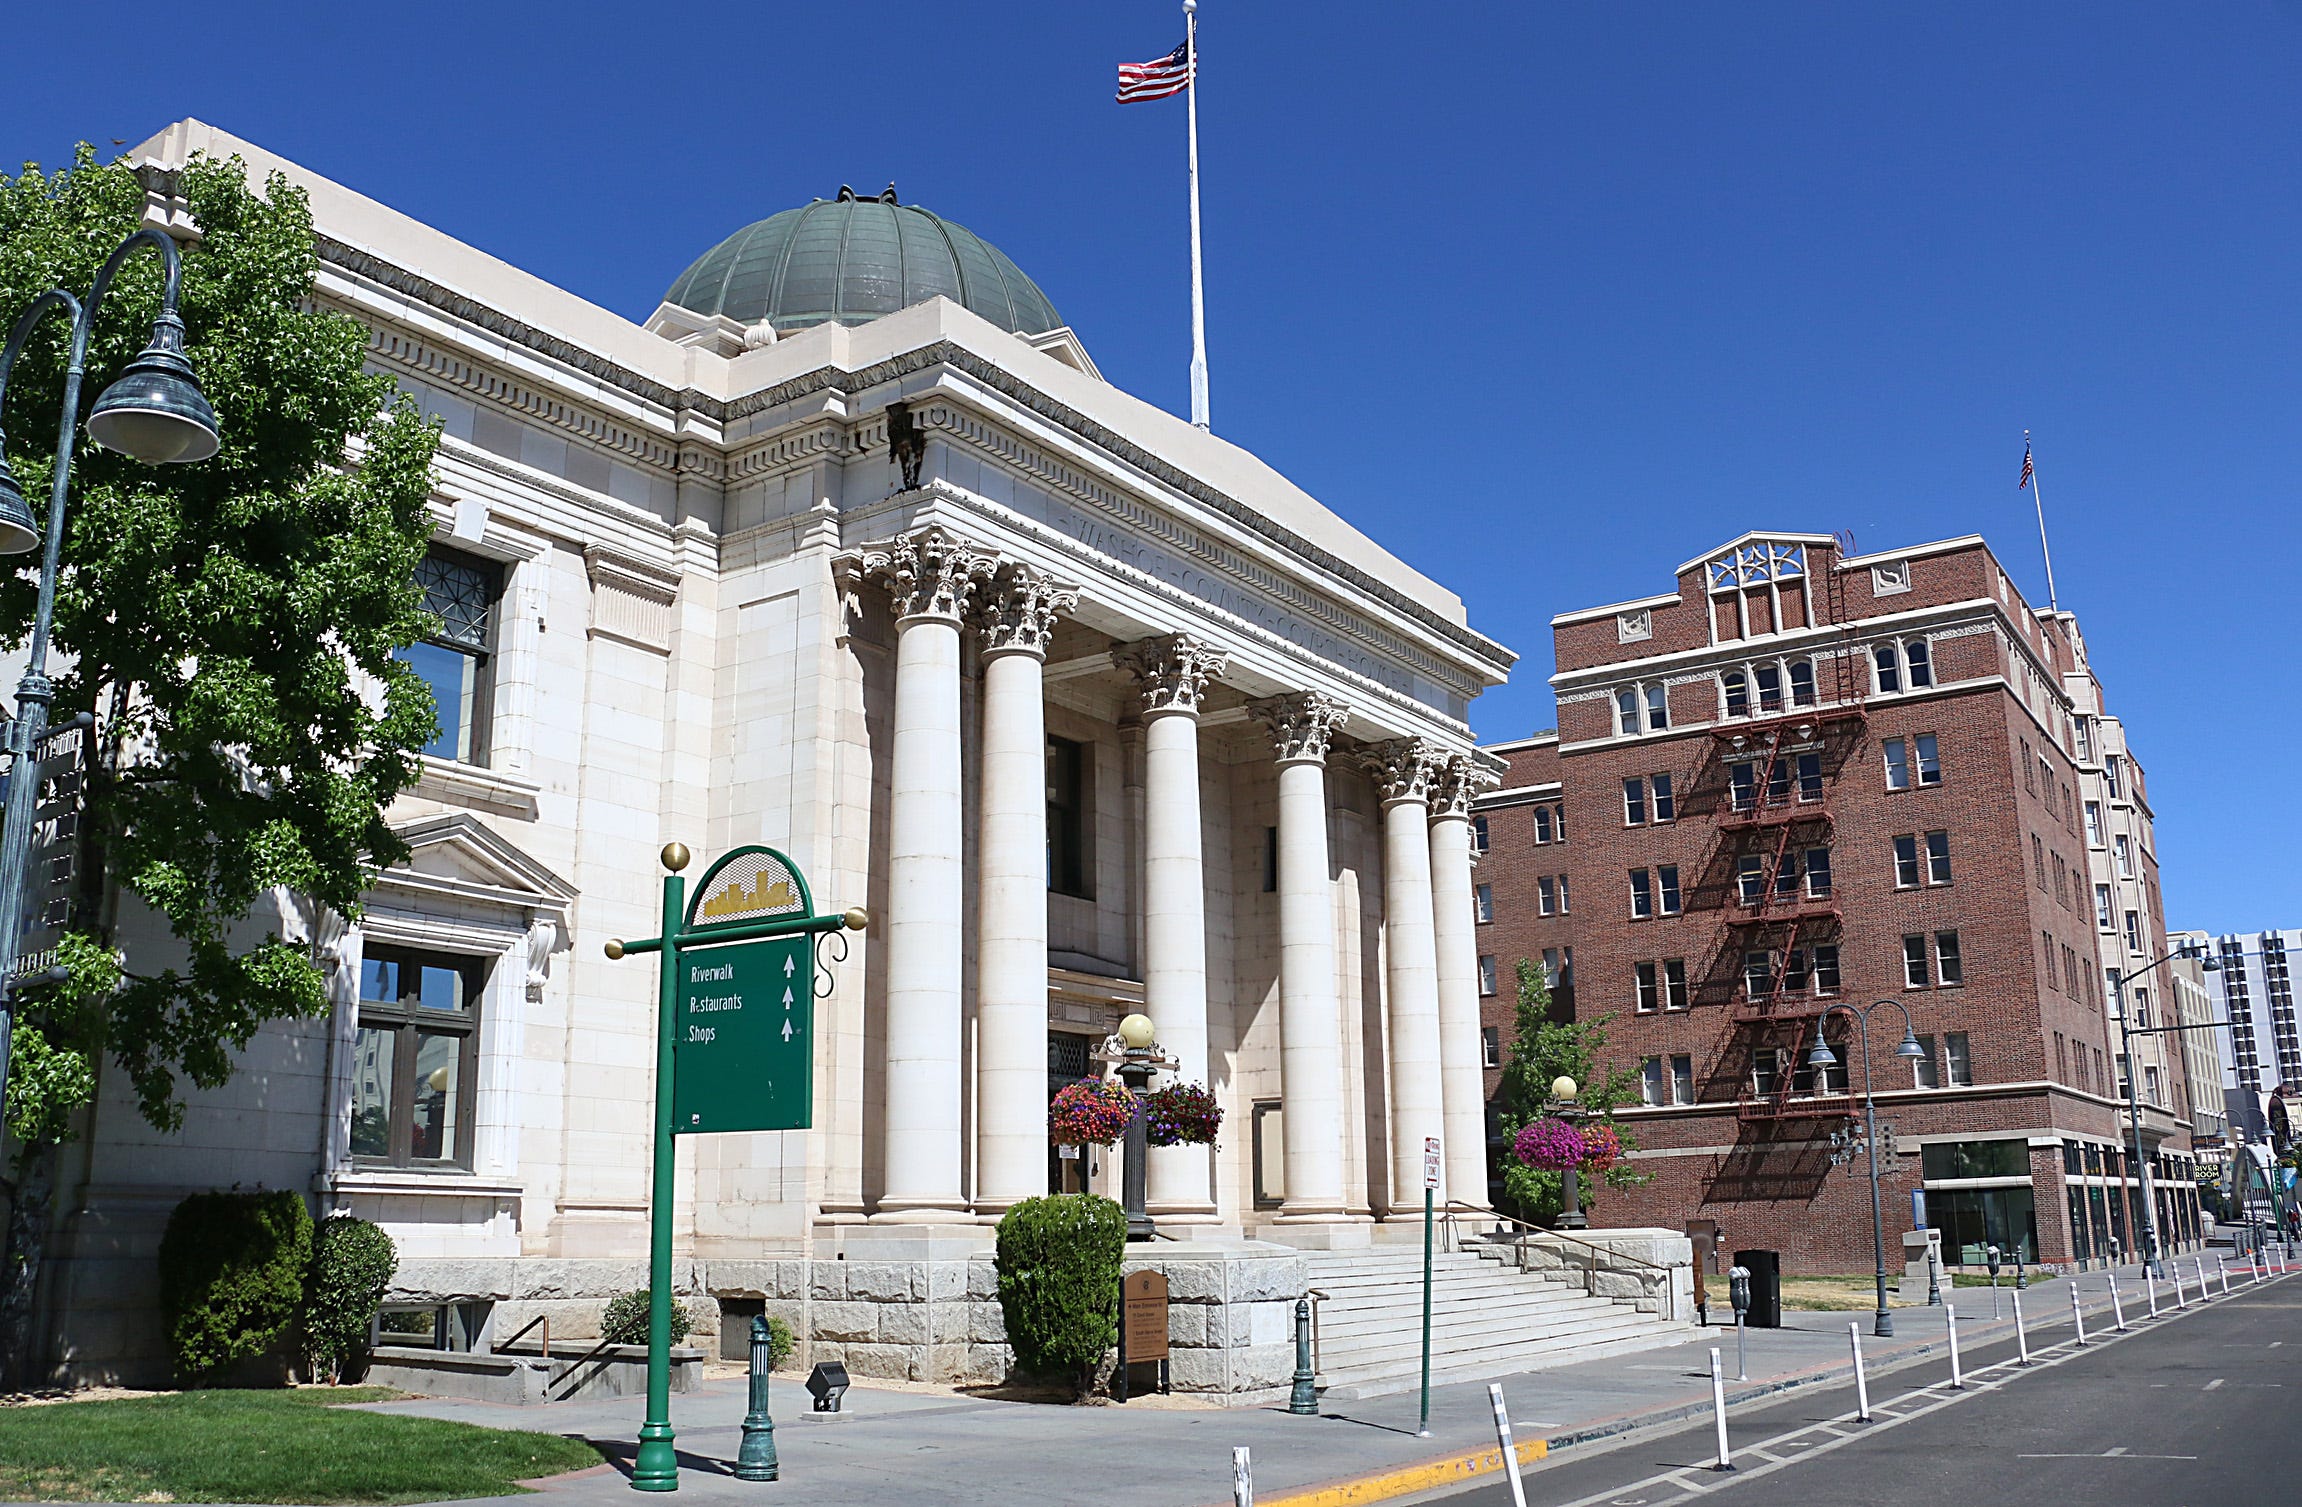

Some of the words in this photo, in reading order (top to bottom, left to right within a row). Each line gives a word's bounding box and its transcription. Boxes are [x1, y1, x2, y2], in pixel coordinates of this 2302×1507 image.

[691, 963, 733, 982] Riverwalk
[690, 994, 742, 1013] Restaurants
[689, 1025, 715, 1044] Shops
[2195, 1164, 2218, 1172] RIVER
